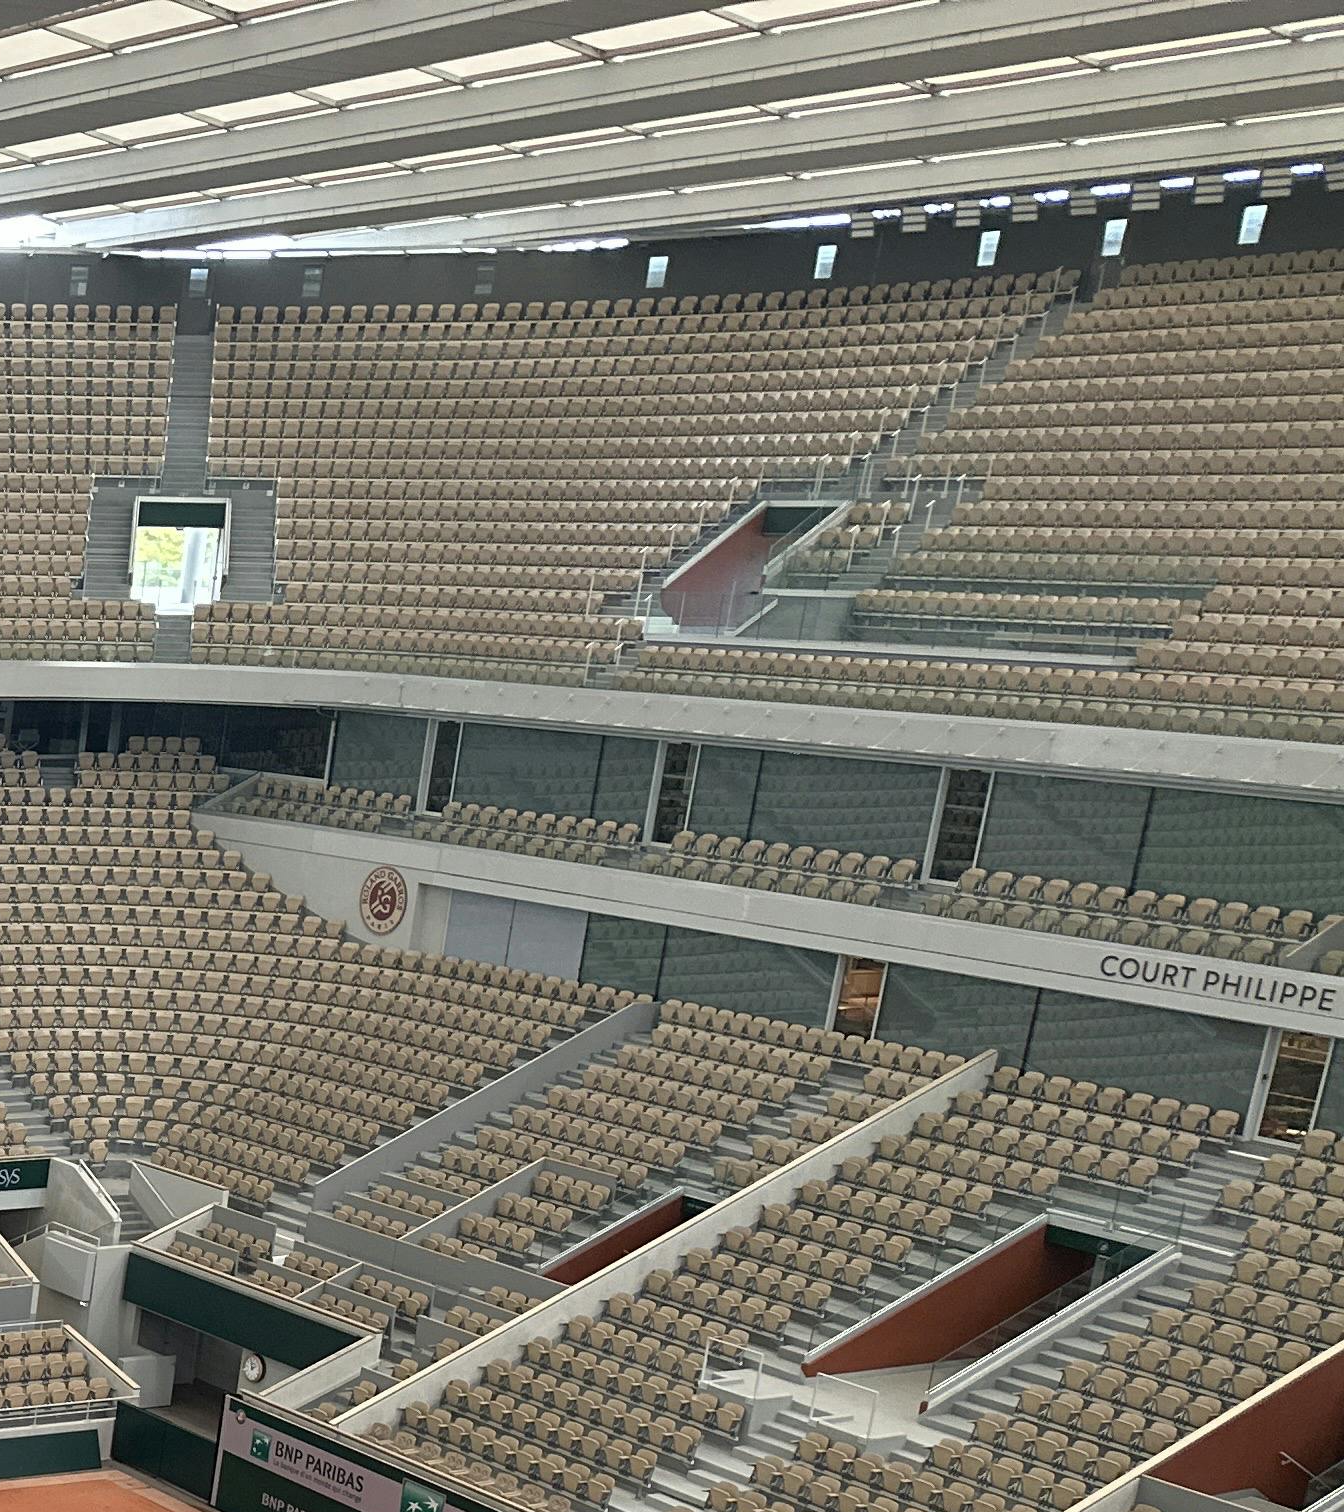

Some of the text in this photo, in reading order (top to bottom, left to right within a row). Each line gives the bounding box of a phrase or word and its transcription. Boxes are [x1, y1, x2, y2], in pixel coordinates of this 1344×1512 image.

[1100, 955, 1337, 1012] COURT PHILIPPE
[275, 1440, 365, 1493] BNP PARIBAS
[262, 1492, 285, 1512] BNP
